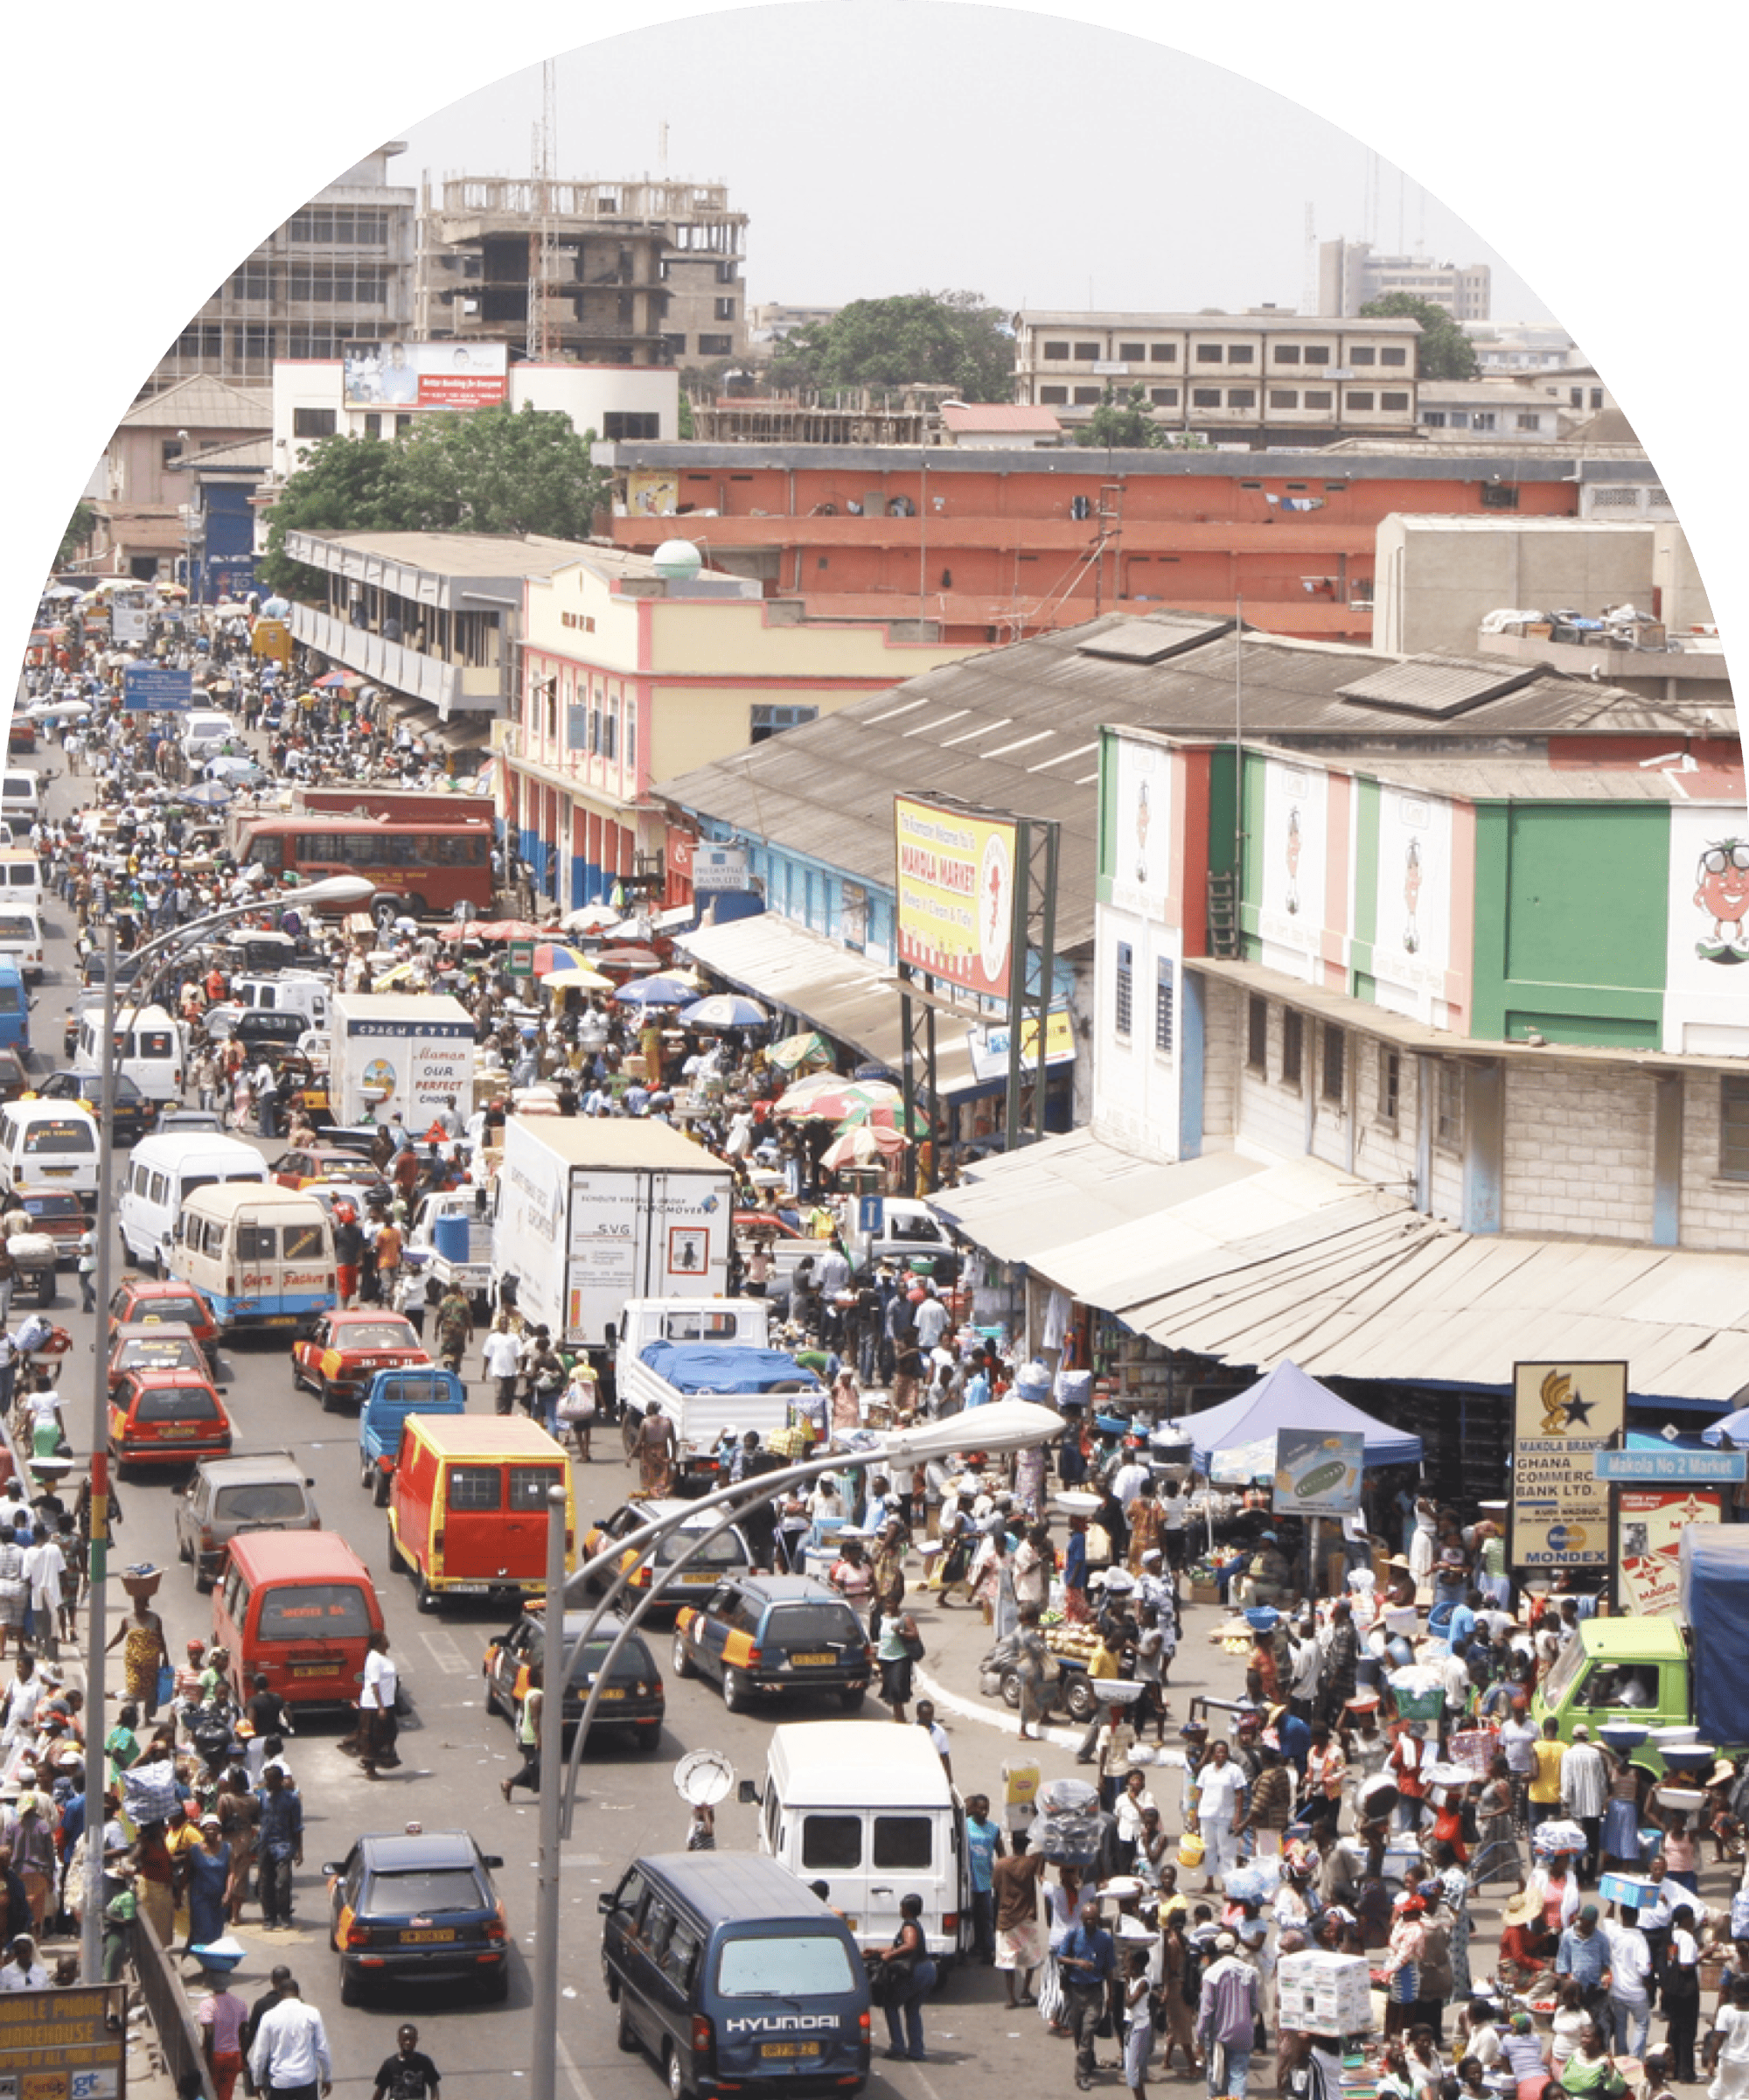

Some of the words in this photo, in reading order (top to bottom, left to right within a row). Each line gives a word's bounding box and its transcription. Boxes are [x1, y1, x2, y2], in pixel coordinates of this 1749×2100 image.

[902, 846, 937, 880] MAKOLA
[940, 858, 976, 893] MARKET
[424, 1066, 454, 1076] OUR
[415, 1081, 463, 1091] PERFECT
[419, 1094, 456, 1104] CHOIC
[1520, 1442, 1563, 1451] MAKOLA
[1517, 1457, 1571, 1469] GHANA
[1609, 1458, 1653, 1474] Makola
[1657, 1459, 1675, 1474] No
[1677, 1459, 1685, 1474] 2
[1690, 1458, 1732, 1474] Market
[1516, 1471, 1594, 1483] COMMERC
[1516, 1486, 1557, 1497] BANK
[1564, 1485, 1597, 1497] LTD.
[1525, 1552, 1606, 1562] MONDEX
[1639, 1583, 1677, 1601] MAGGI
[53, 1996, 103, 2017] PHONE
[727, 2015, 840, 2031] HYUNDAI
[73, 2072, 99, 2097] gt
